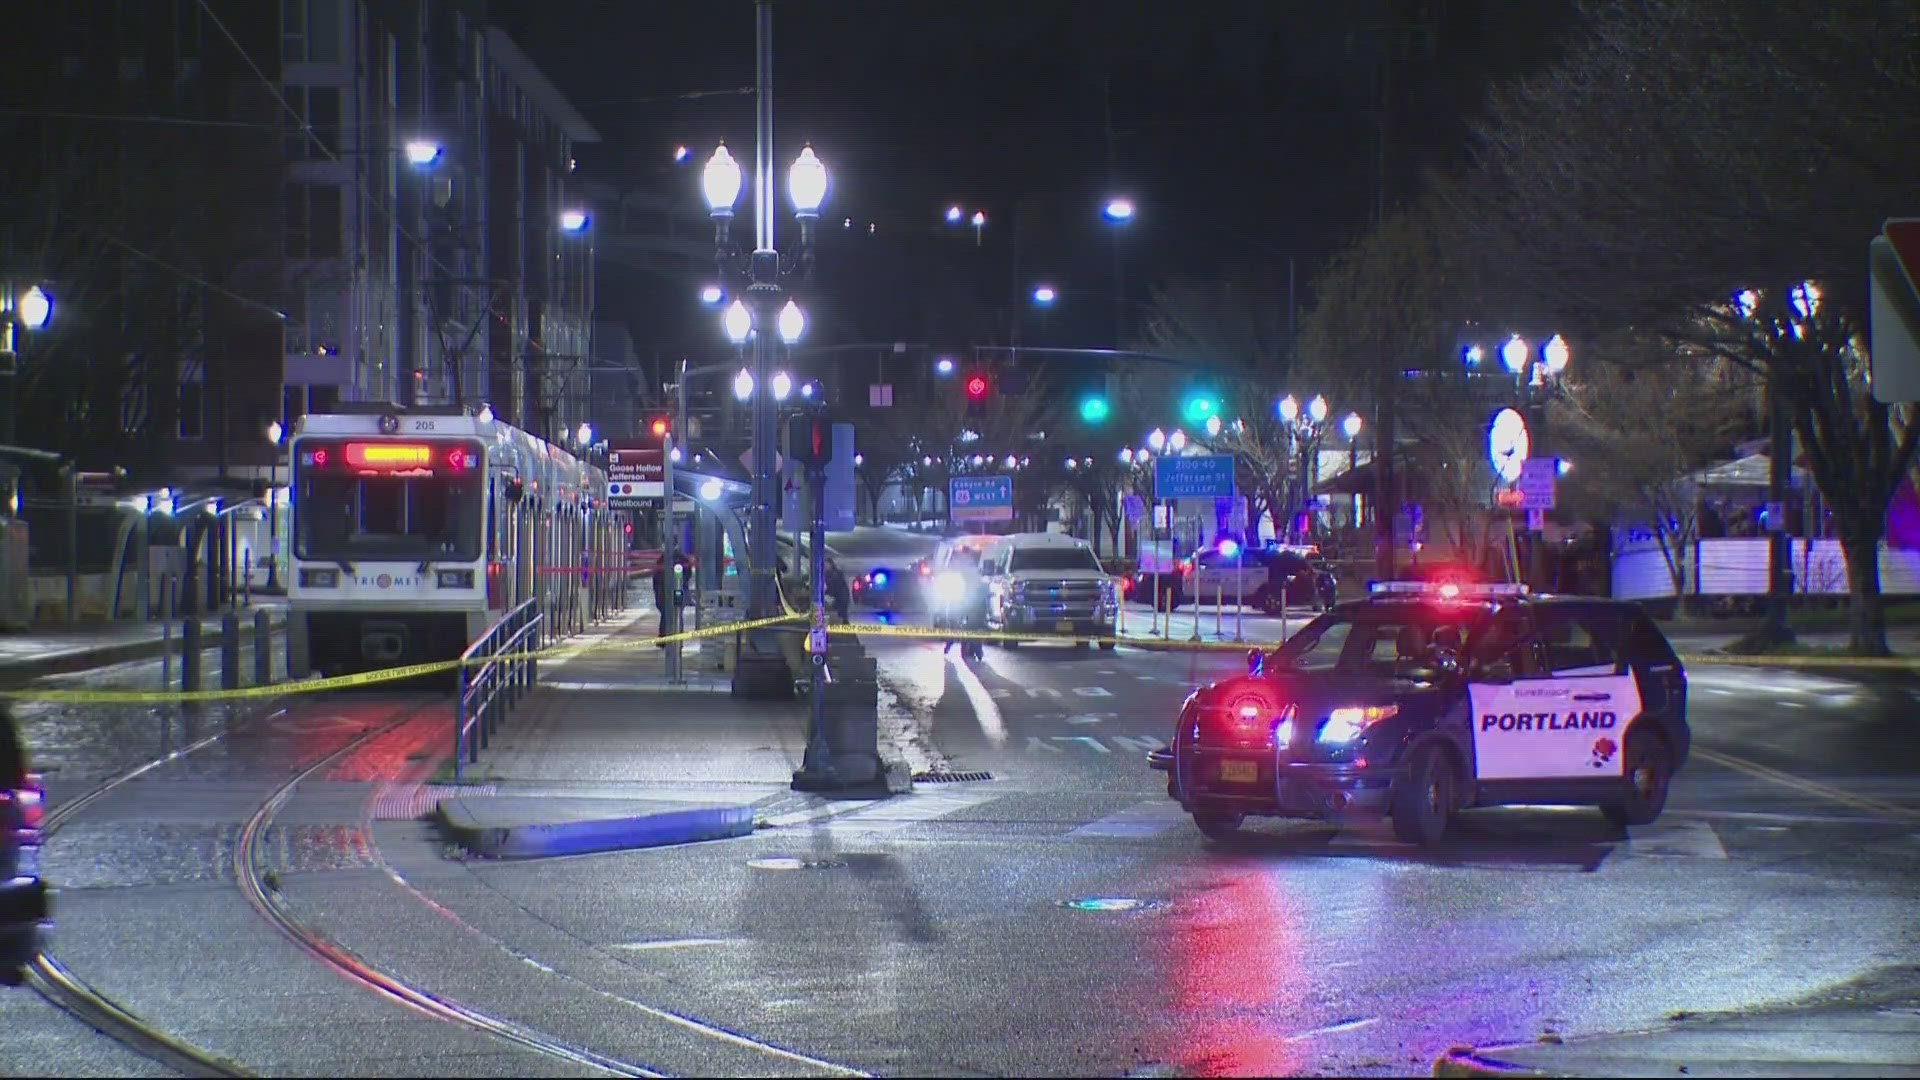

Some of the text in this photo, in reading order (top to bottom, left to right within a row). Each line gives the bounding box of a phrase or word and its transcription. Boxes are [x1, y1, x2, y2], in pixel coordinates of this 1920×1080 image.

[415, 420, 435, 431] 205
[609, 464, 662, 472] Goose Hollow
[609, 473, 646, 481] Jefferson
[610, 499, 653, 507] Westbound
[1481, 711, 1617, 732] PORTLAND
